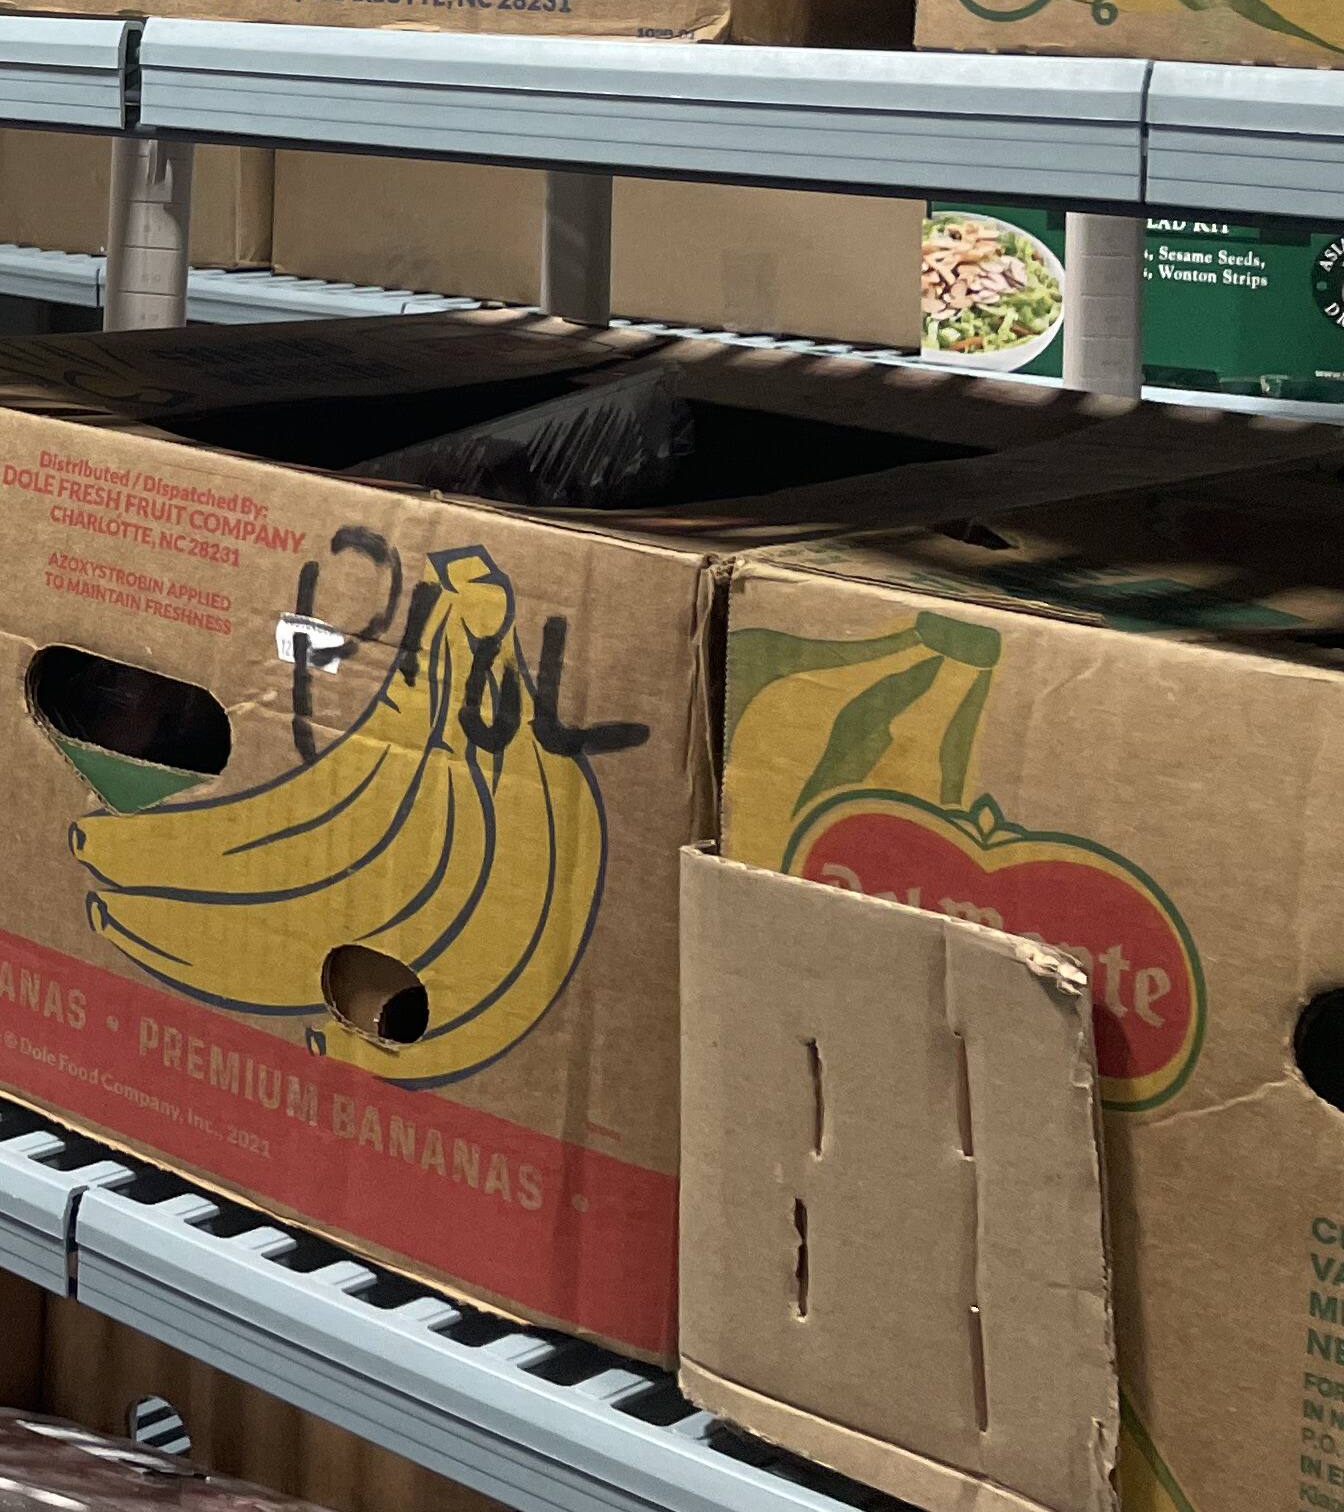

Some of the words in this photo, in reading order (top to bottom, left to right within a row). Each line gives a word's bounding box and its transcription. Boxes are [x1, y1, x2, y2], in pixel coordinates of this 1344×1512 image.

[1158, 245, 1213, 264] Sesame
[1218, 249, 1266, 269] Seeds,
[1158, 264, 1217, 284] Wonton
[1222, 269, 1268, 289] Strips
[2, 464, 55, 495] DOLE
[57, 478, 122, 511] FRESH
[124, 495, 186, 526] FRUIT
[189, 509, 306, 554] COMPANY
[39, 450, 130, 487] Distributed
[143, 475, 238, 516] Dispatched
[240, 497, 268, 521] By:
[50, 505, 156, 548] CHARLOTTE,
[159, 530, 186, 554] NC
[188, 536, 240, 568] 28231
[44, 571, 65, 590] TO
[67, 576, 141, 611] MAINTAIN
[144, 599, 232, 636] FRESHNESS
[48, 551, 164, 594] AZOXYSTROBIN
[167, 583, 231, 612] APPLIED
[19, 1036, 57, 1069] Dole
[58, 1054, 99, 1087] Food
[101, 1071, 184, 1124] Company,
[226, 1122, 273, 1161] 2021
[137, 1015, 320, 1128] PREMIUM
[332, 1092, 545, 1212] BANANAS
